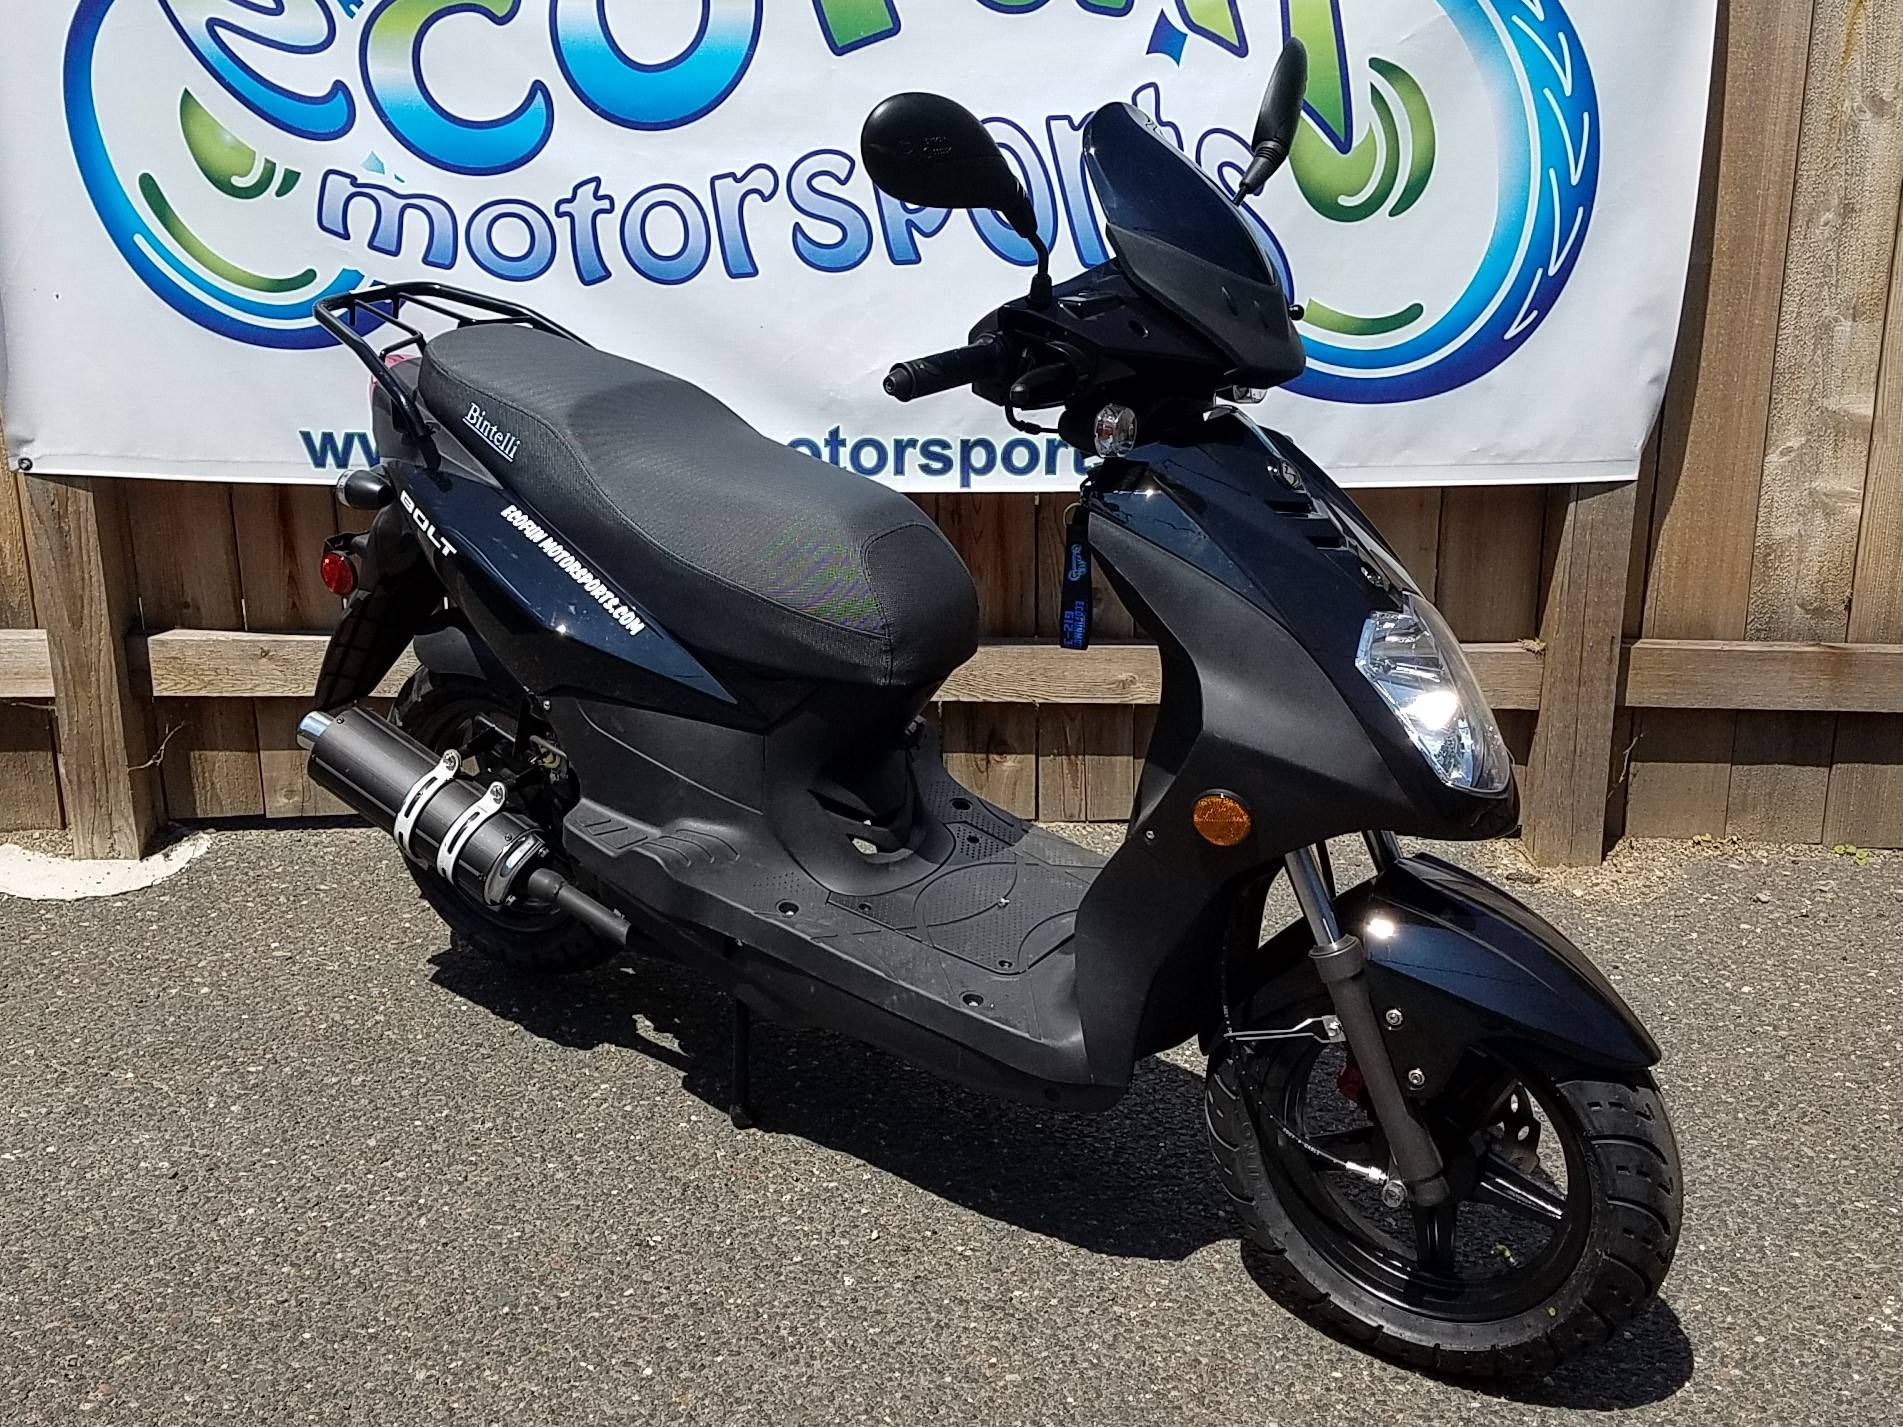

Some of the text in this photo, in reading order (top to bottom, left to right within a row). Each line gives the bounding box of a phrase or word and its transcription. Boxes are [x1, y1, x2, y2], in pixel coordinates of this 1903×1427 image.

[317, 82, 1296, 306] motorspors
[463, 402, 520, 460] Bintelli
[400, 489, 457, 557] BOLT
[501, 504, 645, 636] ECOFUN MOTORSPORTS.COM
